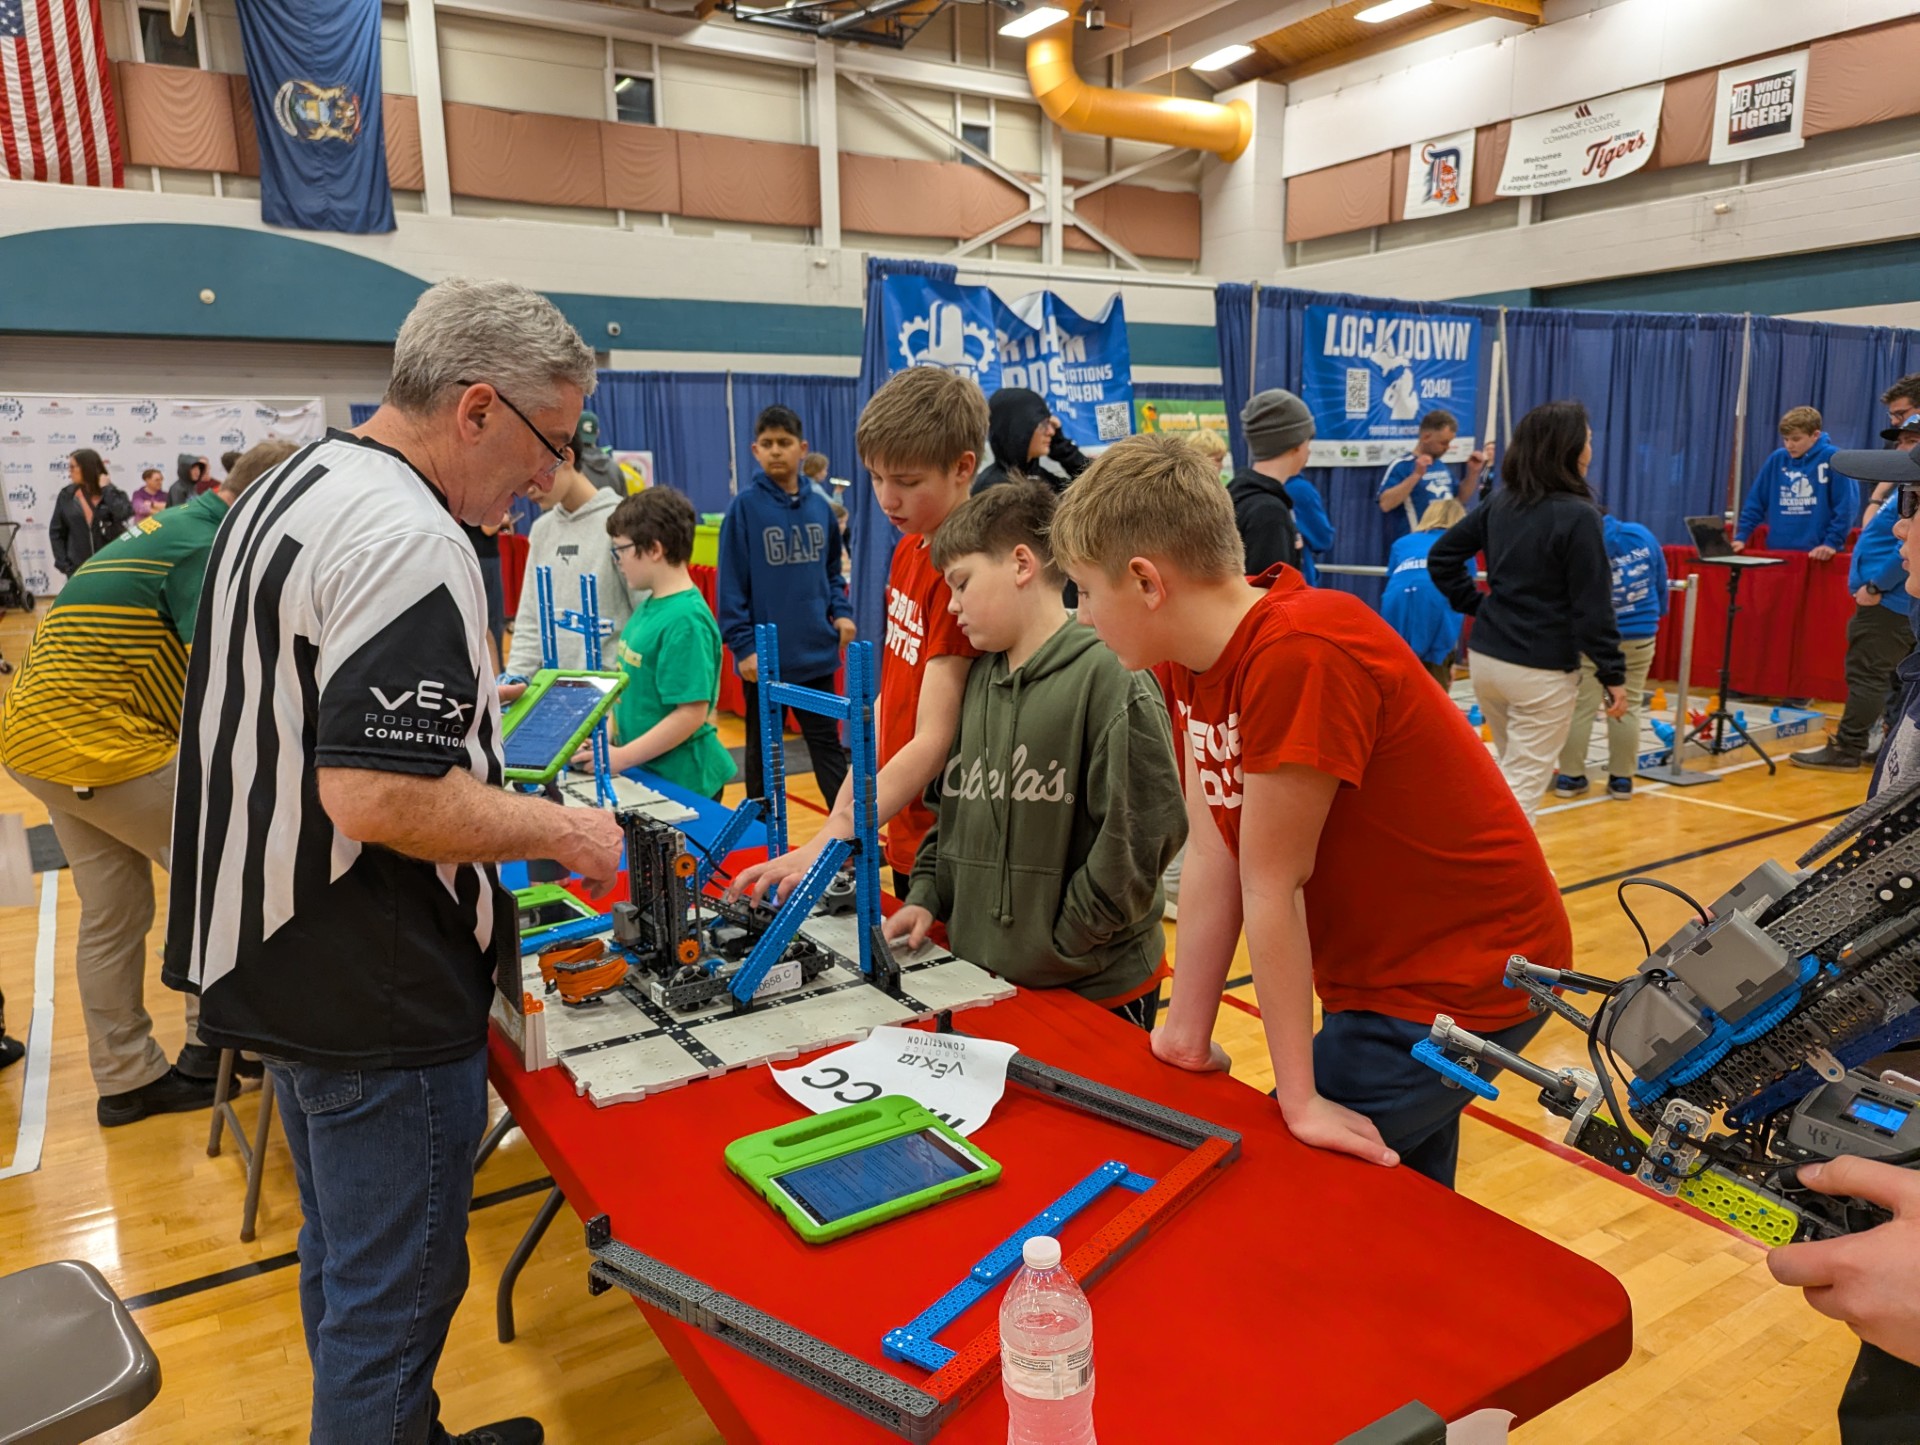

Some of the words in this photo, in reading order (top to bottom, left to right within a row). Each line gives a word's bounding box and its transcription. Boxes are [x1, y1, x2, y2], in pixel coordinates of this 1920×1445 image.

[1754, 76, 1793, 95] WHO'S
[1753, 88, 1791, 109] YOUR
[1584, 113, 1615, 126] COUNTY
[1731, 102, 1793, 132] TIGER?
[1542, 128, 1587, 145] COMMUNITY
[1588, 119, 1622, 134] COLLEGE
[1524, 152, 1562, 164] Welcomes
[1582, 132, 1646, 178] Tigers
[1531, 168, 1568, 180] American
[1535, 163, 1549, 171] The
[1323, 313, 1472, 361] LOCKDOWN
[1817, 463, 1829, 484] C
[763, 523, 825, 566] GAP
[368, 680, 474, 722] VEX
[364, 713, 464, 735] ROBOTIC
[907, 1035, 966, 1052] COMPETITION
